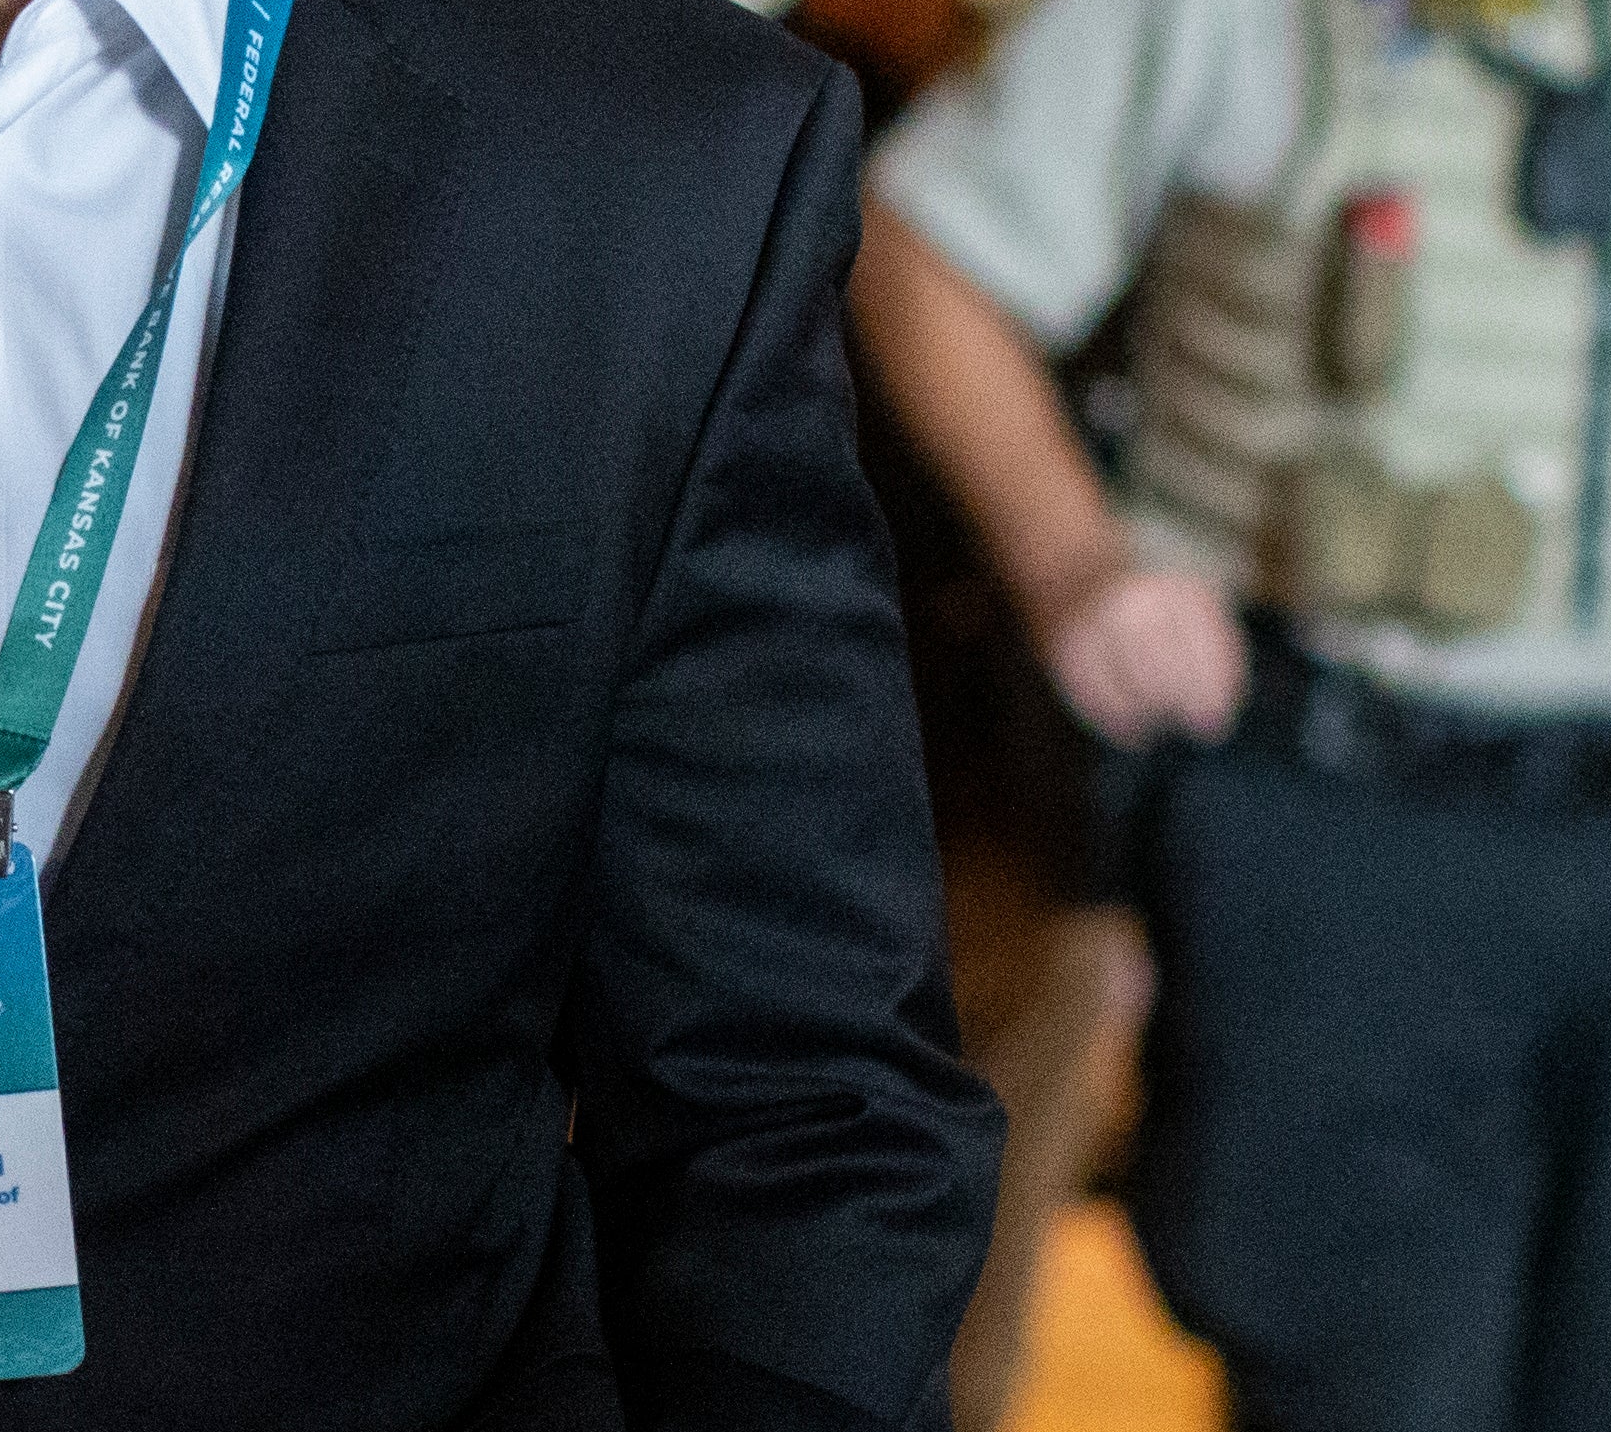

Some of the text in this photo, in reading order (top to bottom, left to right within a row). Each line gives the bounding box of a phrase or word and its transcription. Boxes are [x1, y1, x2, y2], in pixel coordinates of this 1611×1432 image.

[226, 28, 264, 153] FEDERAL
[104, 399, 129, 441] OF
[58, 448, 114, 573] KANSAS
[33, 579, 71, 652] CITY
